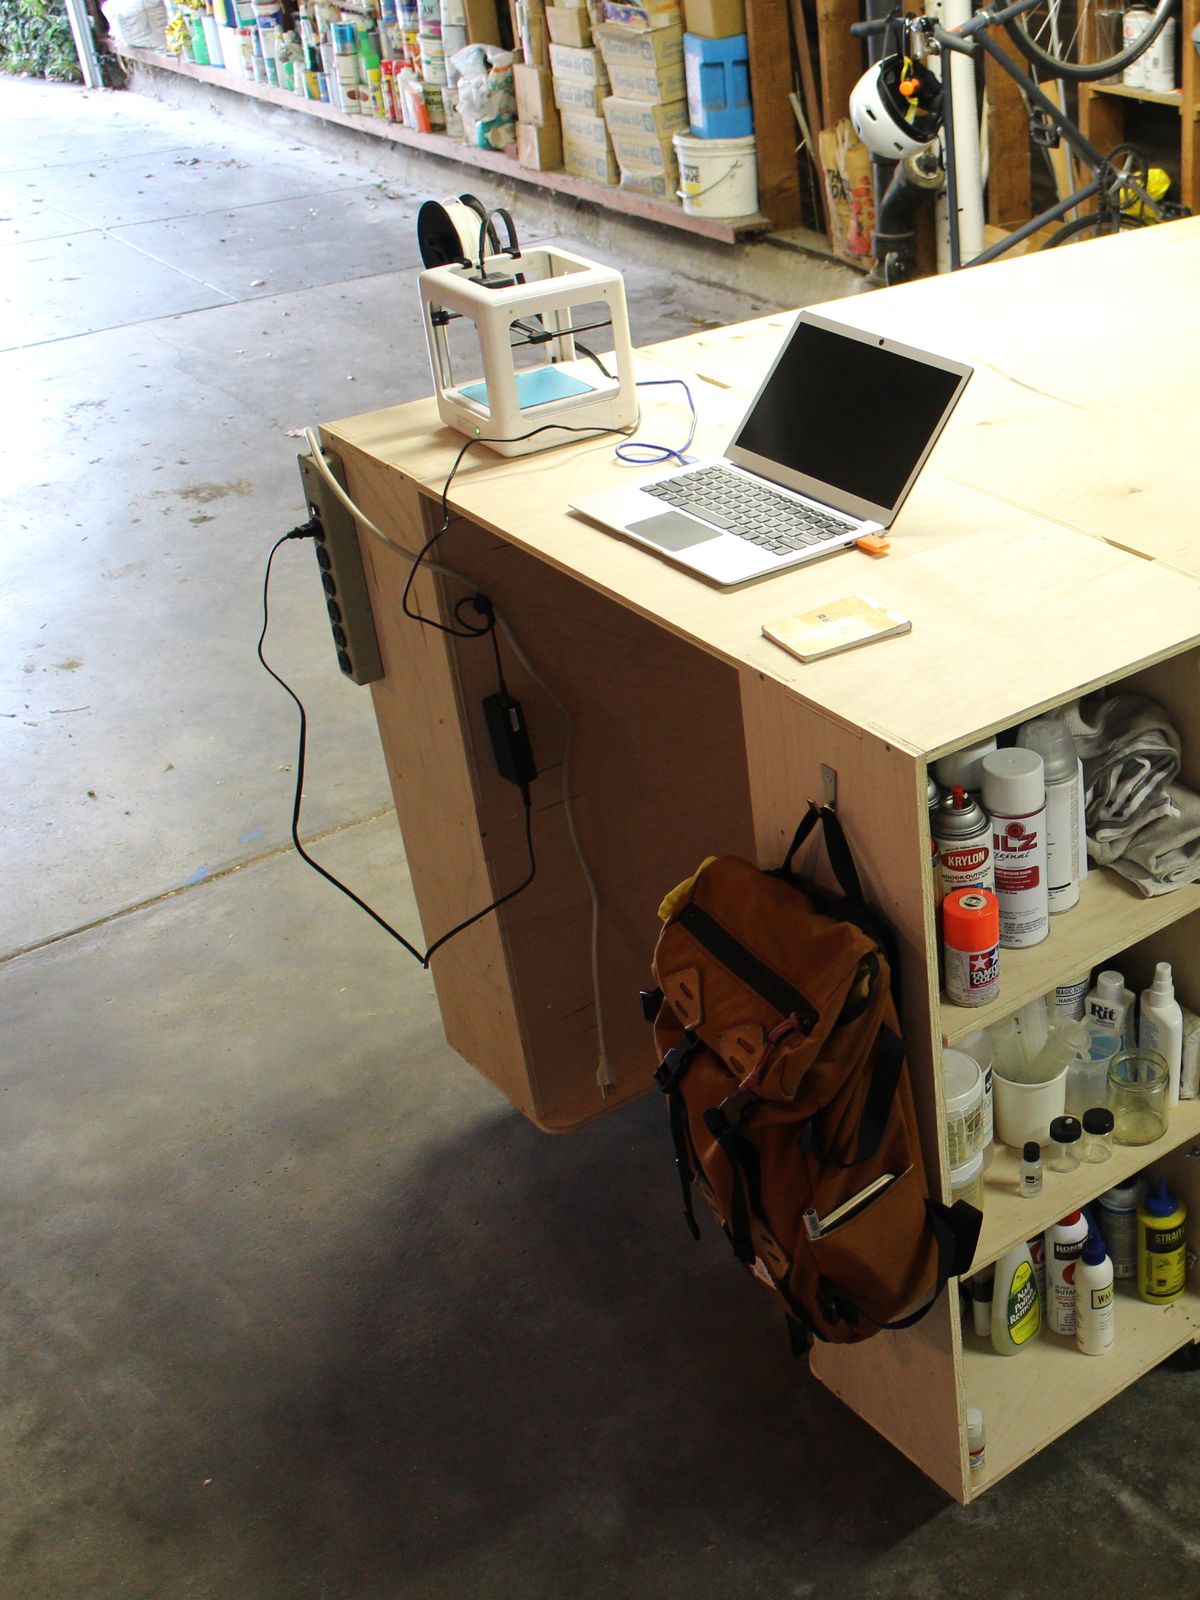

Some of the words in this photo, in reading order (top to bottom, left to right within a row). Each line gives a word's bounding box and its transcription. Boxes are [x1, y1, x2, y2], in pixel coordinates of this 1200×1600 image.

[993, 831, 1037, 852] ILZ
[948, 851, 984, 866] KRYLON
[1091, 1003, 1116, 1021] Rit
[1018, 1281, 1031, 1302] Nail
